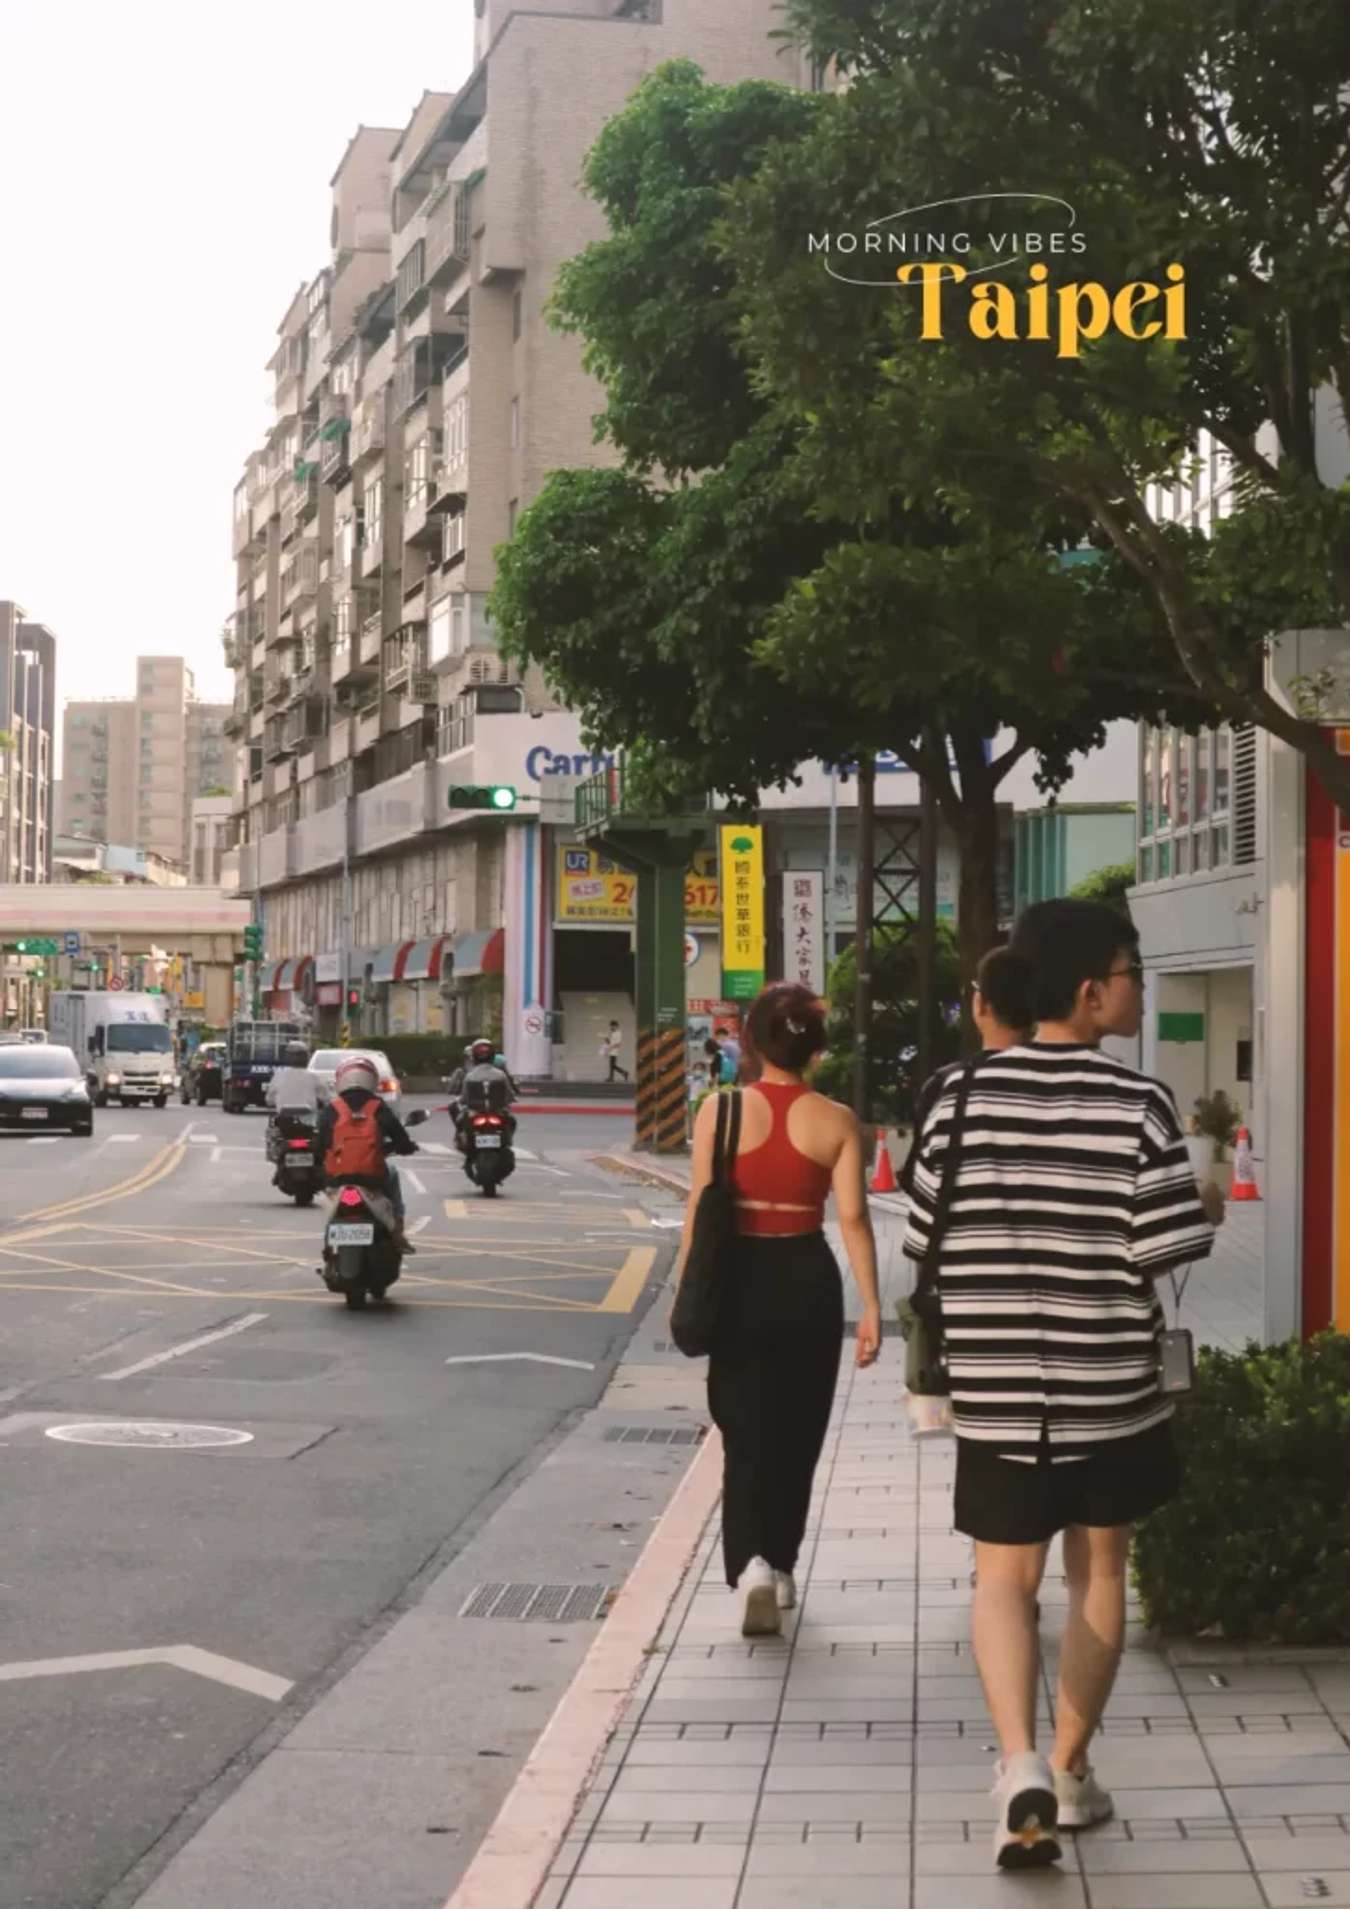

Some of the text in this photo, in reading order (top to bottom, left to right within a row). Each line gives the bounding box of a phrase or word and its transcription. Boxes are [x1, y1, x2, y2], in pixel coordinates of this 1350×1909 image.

[735, 860, 752, 955] 國泰世華銀行
